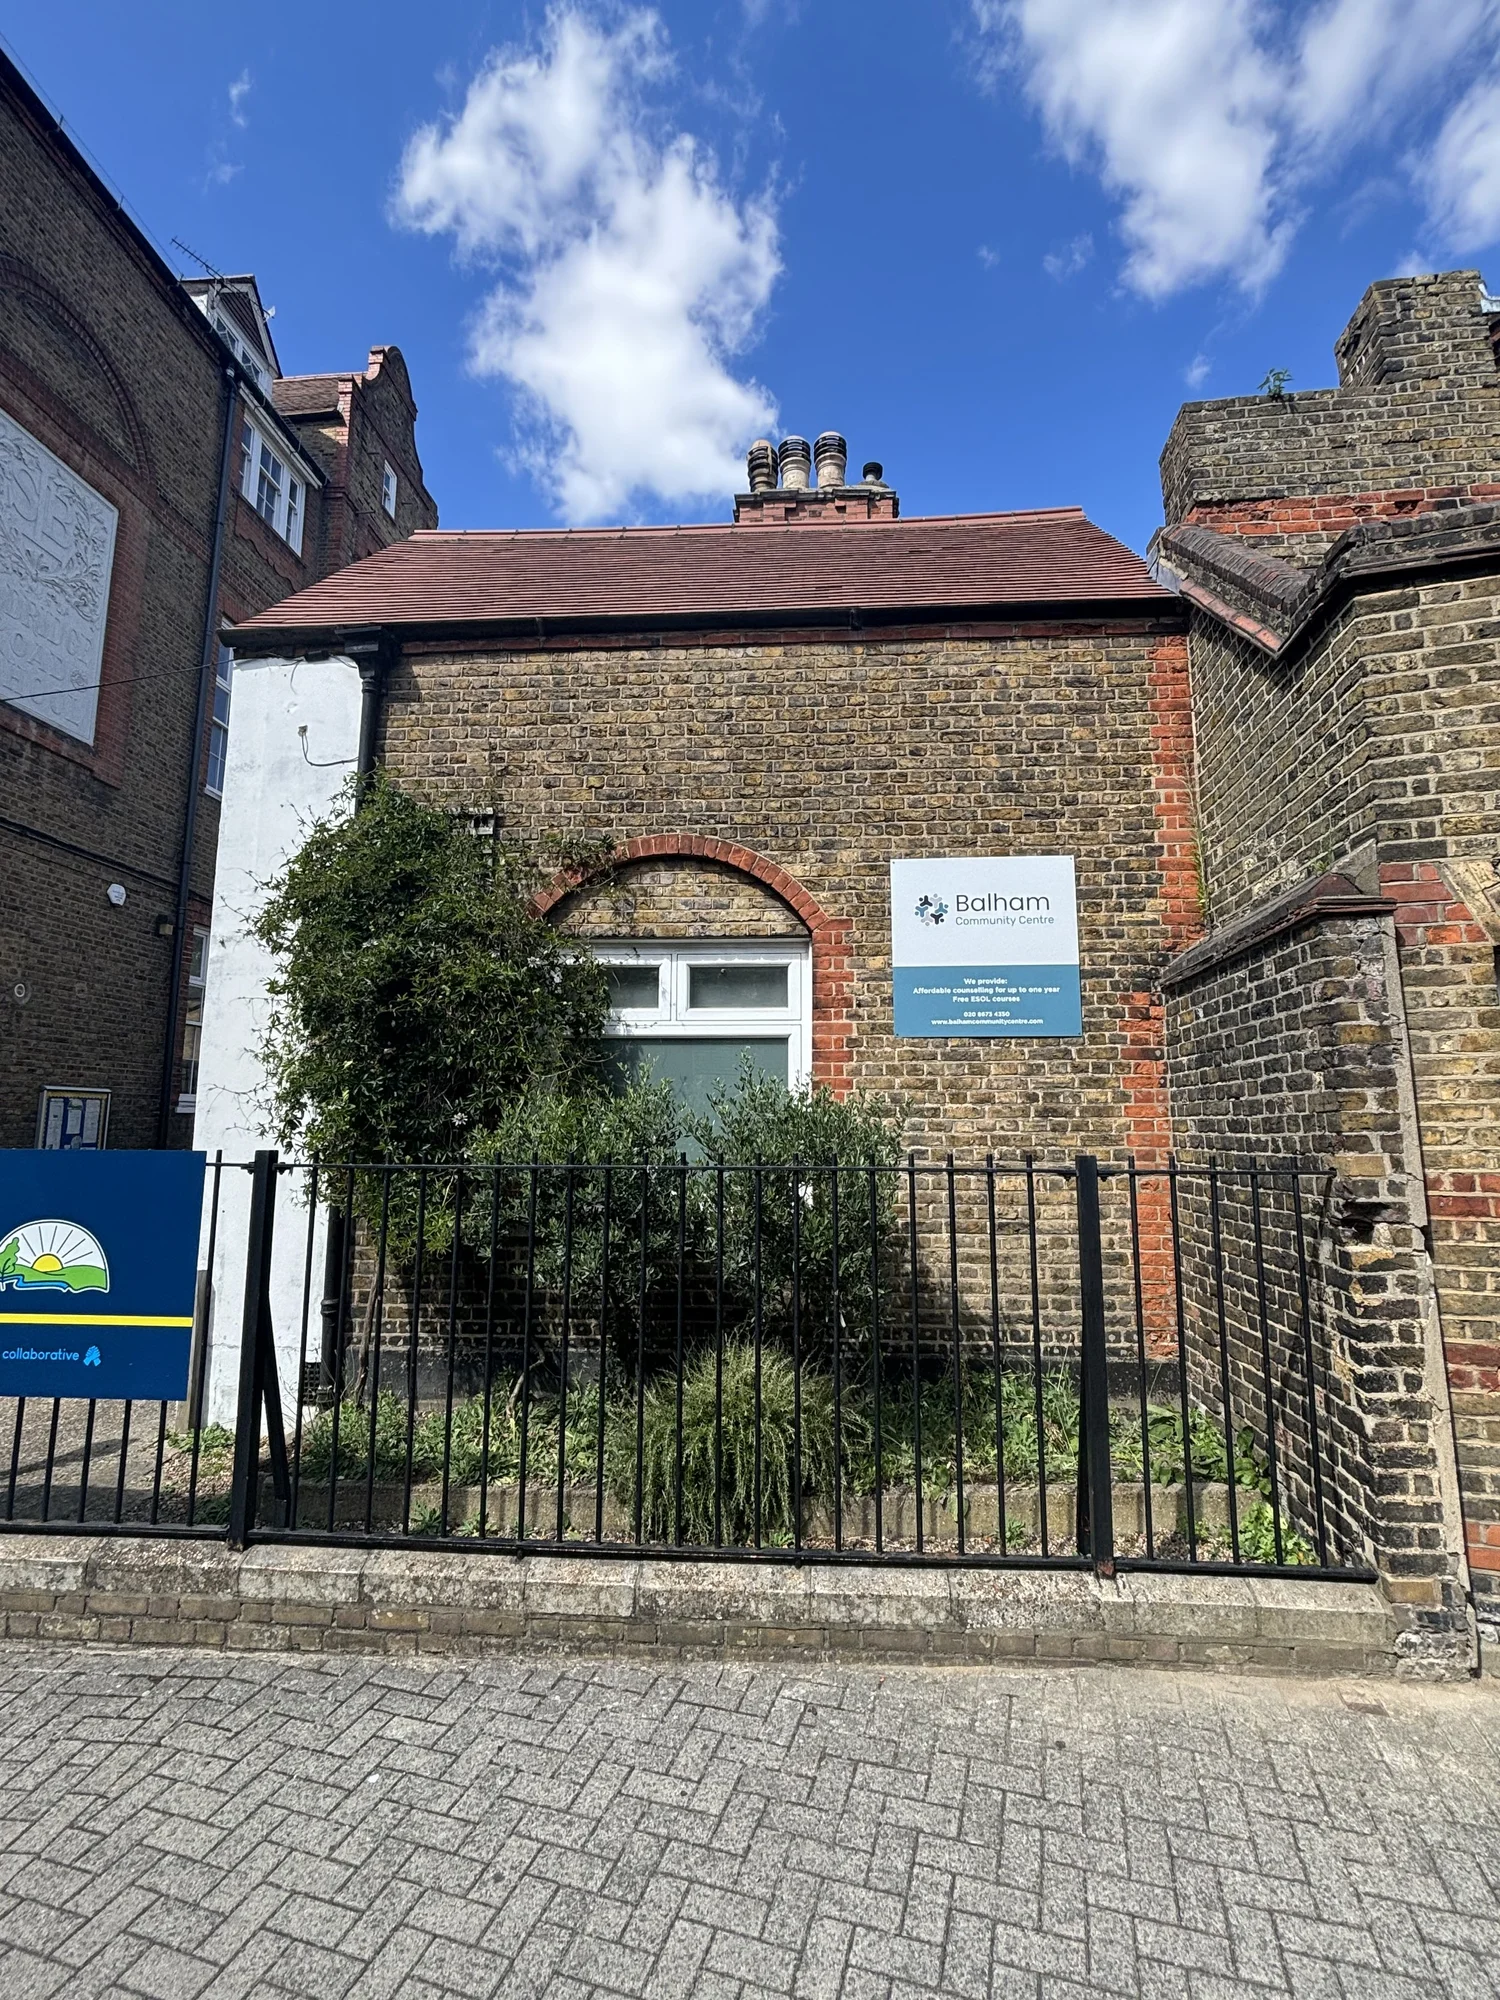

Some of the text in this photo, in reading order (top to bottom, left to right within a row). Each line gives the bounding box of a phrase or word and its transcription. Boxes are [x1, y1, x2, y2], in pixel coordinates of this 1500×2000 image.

[956, 893, 1050, 912] Balham
[955, 915, 1055, 927] Community Centre
[977, 977, 1008, 986] provide:
[912, 987, 952, 995] Affordable
[952, 987, 994, 995] counselling
[995, 986, 1007, 994] for
[1044, 986, 1060, 994] year
[970, 995, 991, 1003] ESOL
[2, 1347, 80, 1361] collaborative
